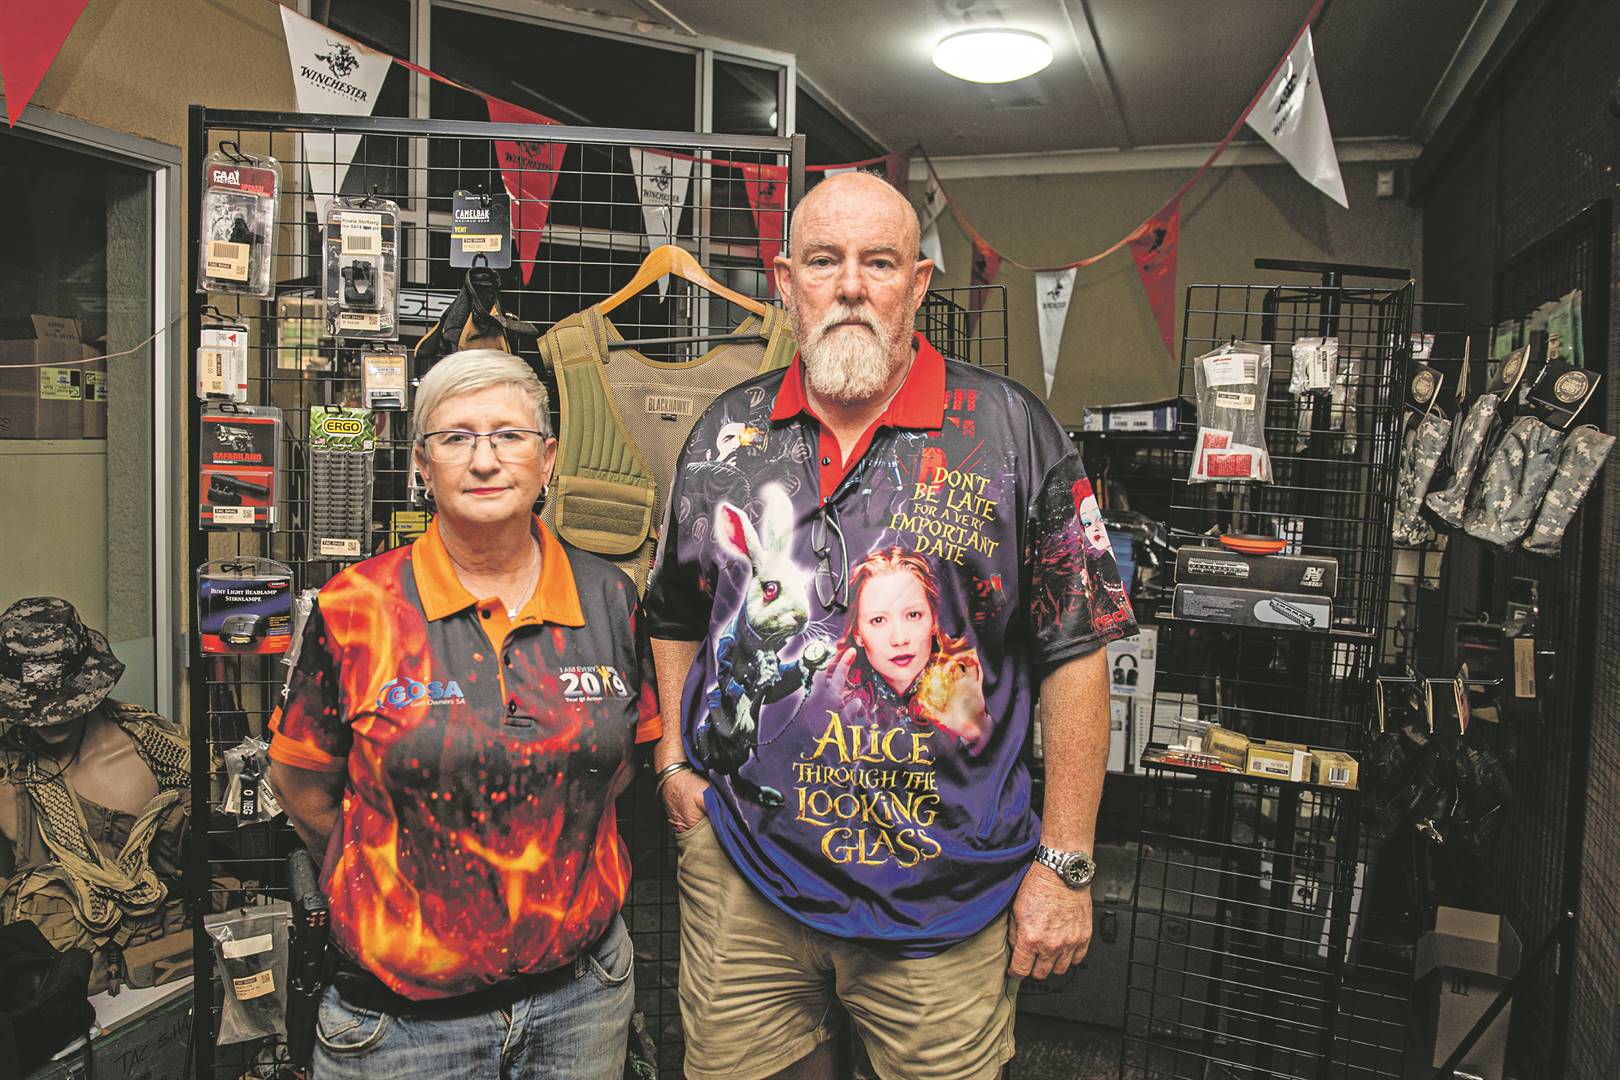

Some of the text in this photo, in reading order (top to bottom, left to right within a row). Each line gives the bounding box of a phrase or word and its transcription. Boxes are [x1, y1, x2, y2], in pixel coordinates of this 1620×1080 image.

[300, 66, 368, 101] WINCHESTER
[213, 170, 234, 181] CAA
[455, 209, 490, 220] CAMELBAK
[327, 421, 360, 431] ERGO
[212, 452, 262, 462] SAFARILAND
[912, 482, 999, 521] BE LATE
[913, 503, 985, 532] FOR A VERY
[889, 512, 999, 559] IMPORTANT
[913, 534, 967, 567] DATE
[792, 761, 938, 791] THROUGH THE
[242, 800, 254, 815] NEG
[793, 787, 941, 828] LOOKING
[821, 827, 942, 868] GLASS
